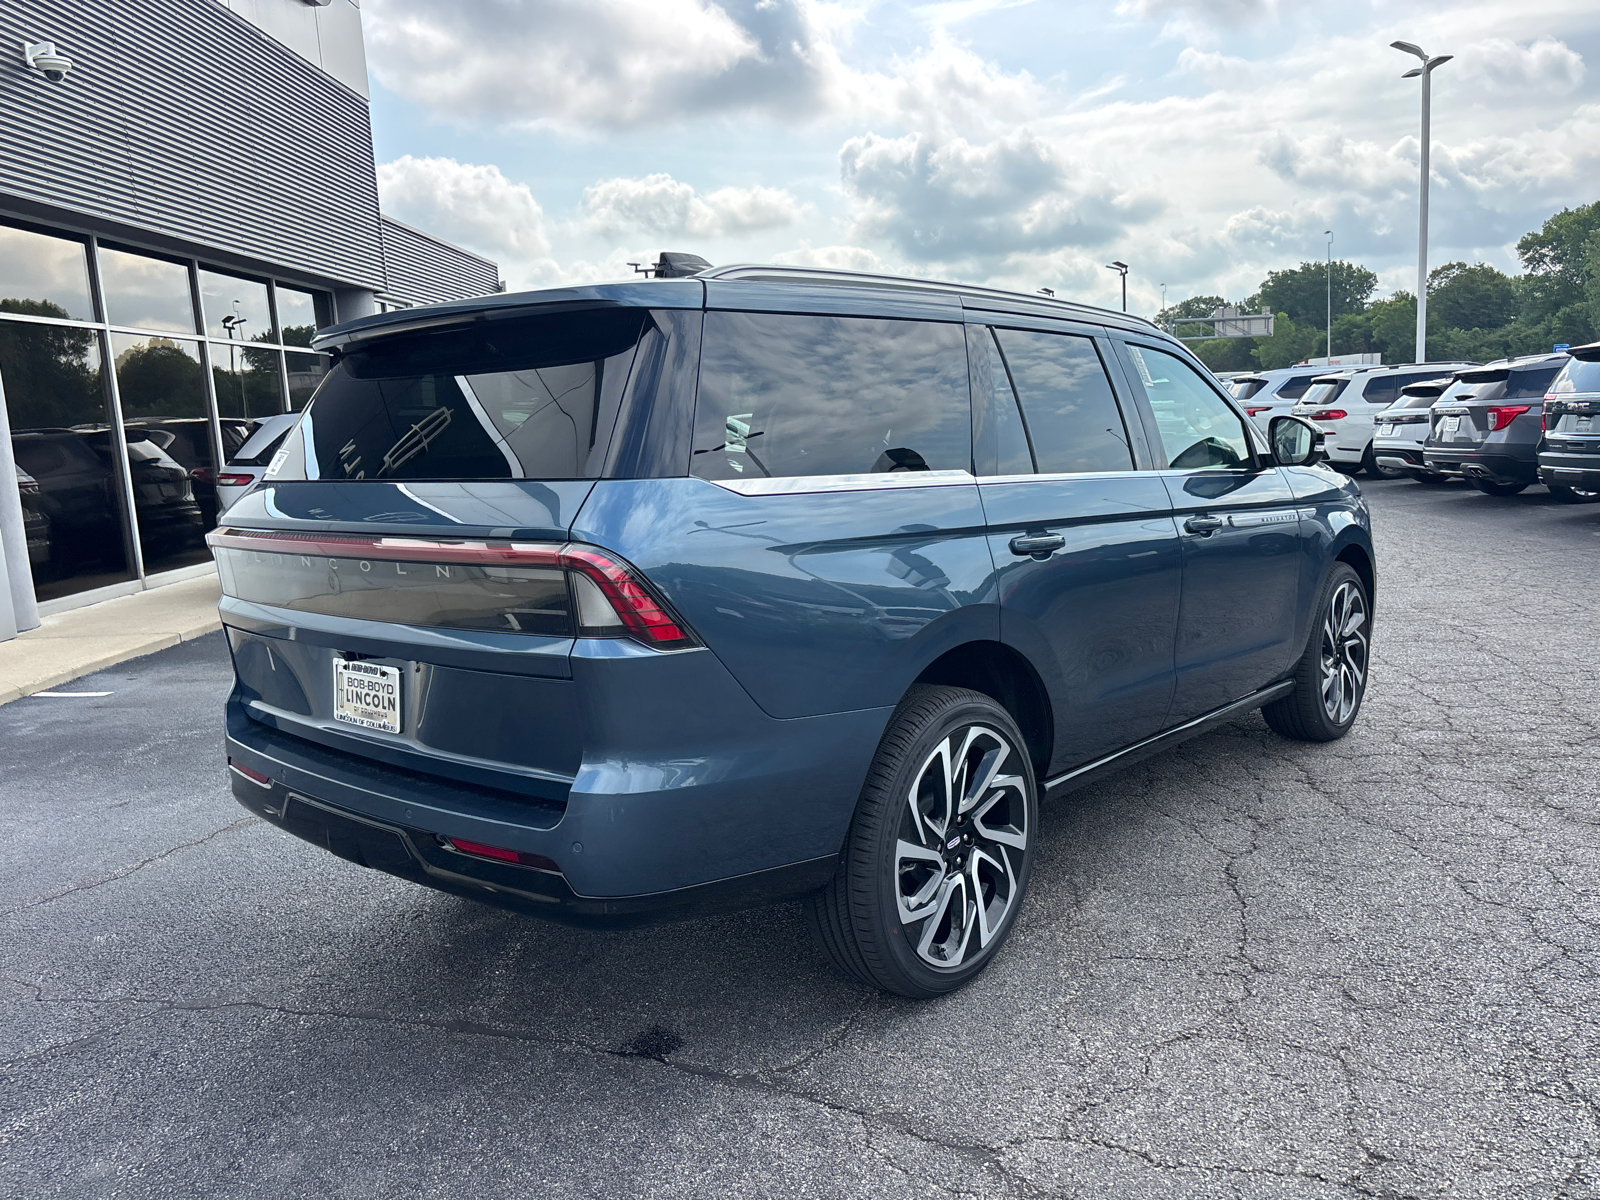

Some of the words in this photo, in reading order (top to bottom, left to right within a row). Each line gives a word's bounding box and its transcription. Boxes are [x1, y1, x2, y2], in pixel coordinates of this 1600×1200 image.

[1261, 514, 1296, 522] NAVIGATOR
[254, 552, 450, 578] LINCOLN
[347, 677, 394, 695] BOB-BOYD
[346, 689, 395, 711] LINCOLN
